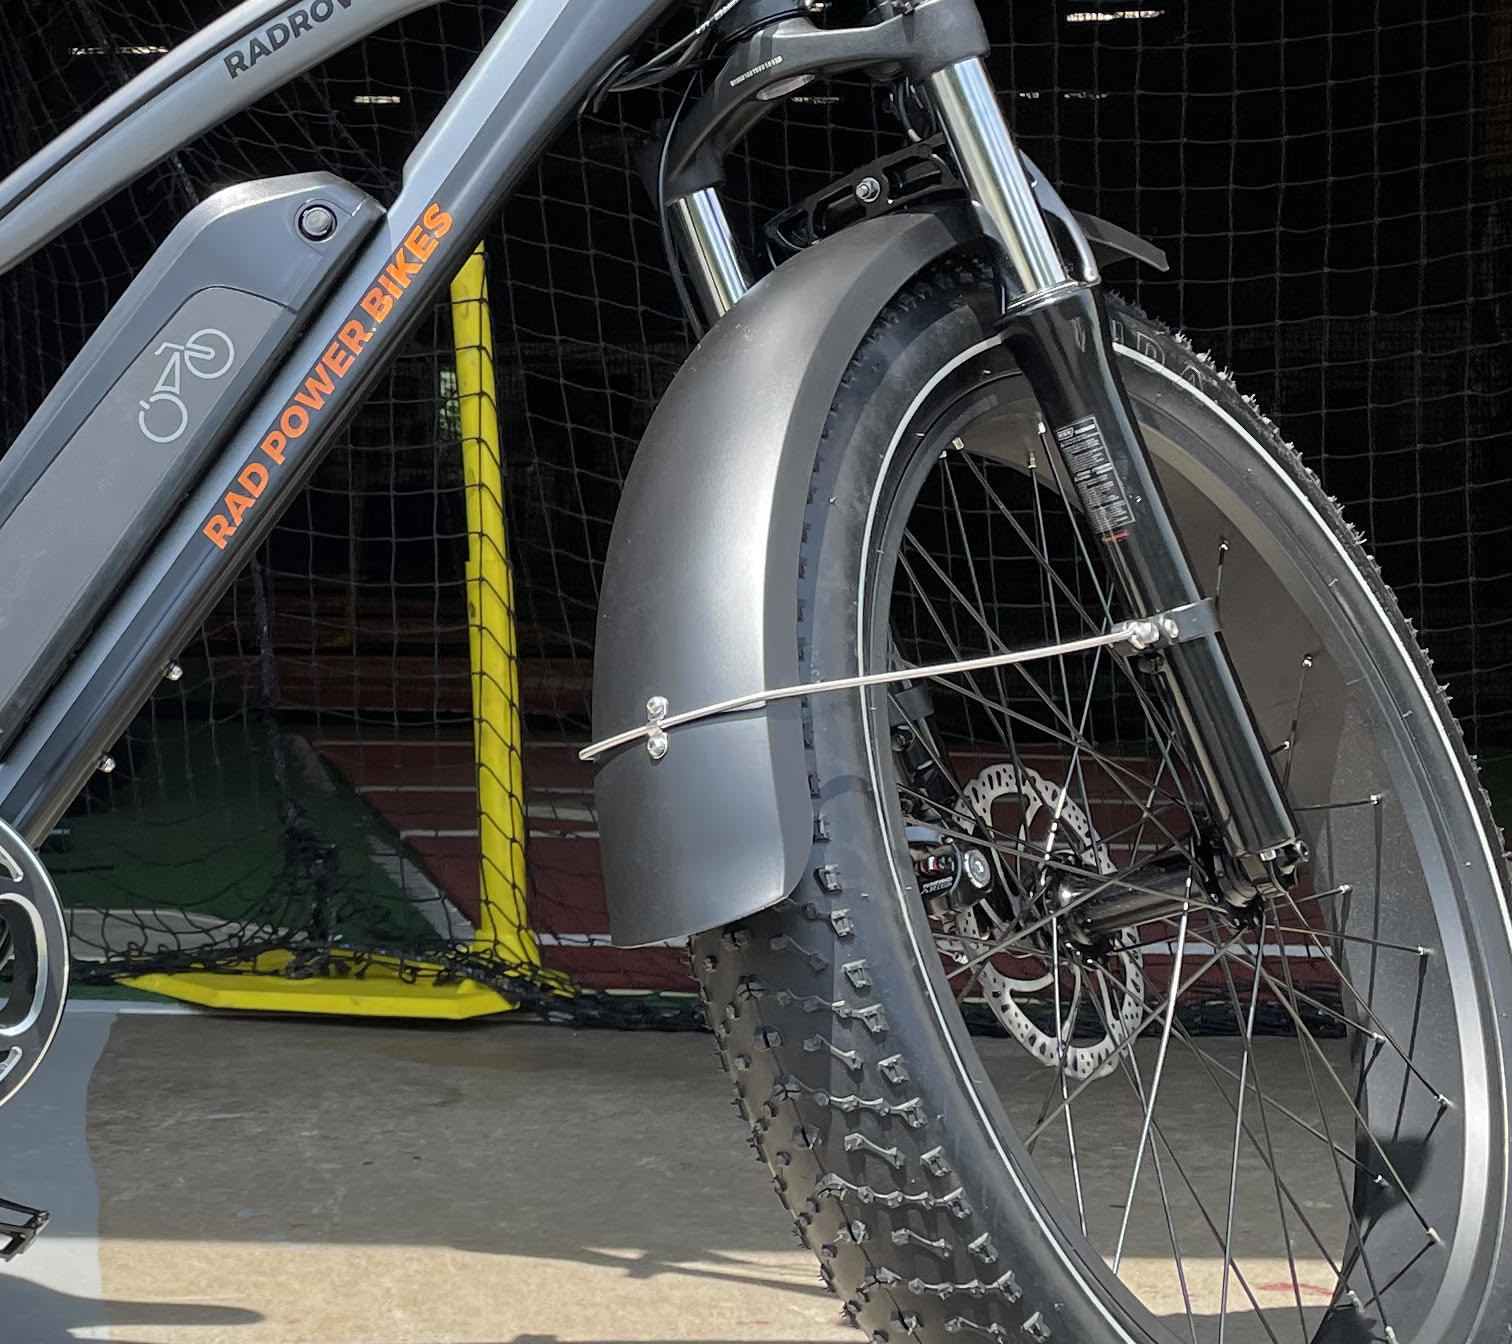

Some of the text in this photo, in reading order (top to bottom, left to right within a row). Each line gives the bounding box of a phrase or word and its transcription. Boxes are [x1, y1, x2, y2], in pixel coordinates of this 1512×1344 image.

[202, 202, 453, 550] RAD POWER BIKES
